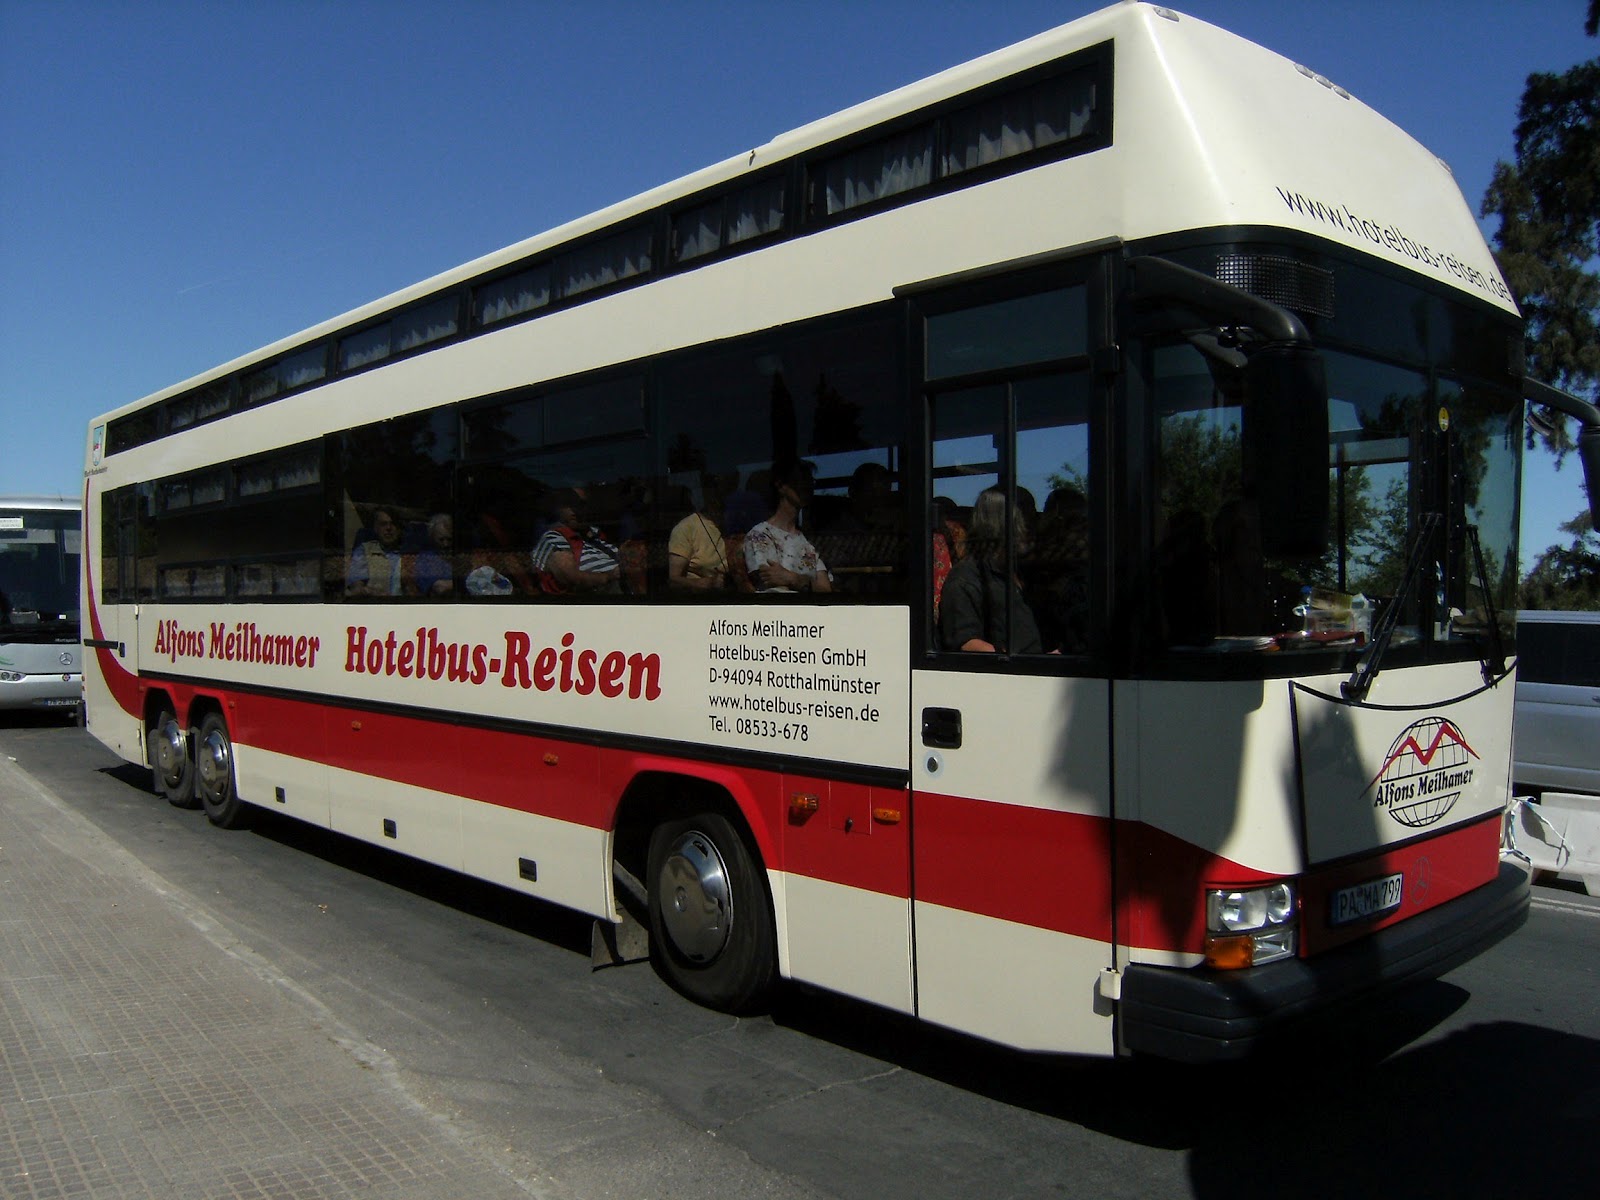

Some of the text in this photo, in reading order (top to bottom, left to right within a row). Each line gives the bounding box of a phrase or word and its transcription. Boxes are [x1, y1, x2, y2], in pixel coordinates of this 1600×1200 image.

[1275, 186, 1512, 302] www.hotelbus-reisen.de
[709, 620, 825, 638] Alfons Meilhamer
[154, 619, 320, 668] Alfons Meilhamer
[709, 644, 867, 667] Hotelbus-Reisen GmbH
[345, 626, 662, 701] Hotelbus-Reisen
[709, 668, 881, 695] D-94094 Rotthalmünster
[709, 694, 880, 722] www.hotelbus-reisen.de
[709, 715, 809, 742] Tel. 08533-678
[1374, 768, 1474, 808] Alfons Meilhamer
